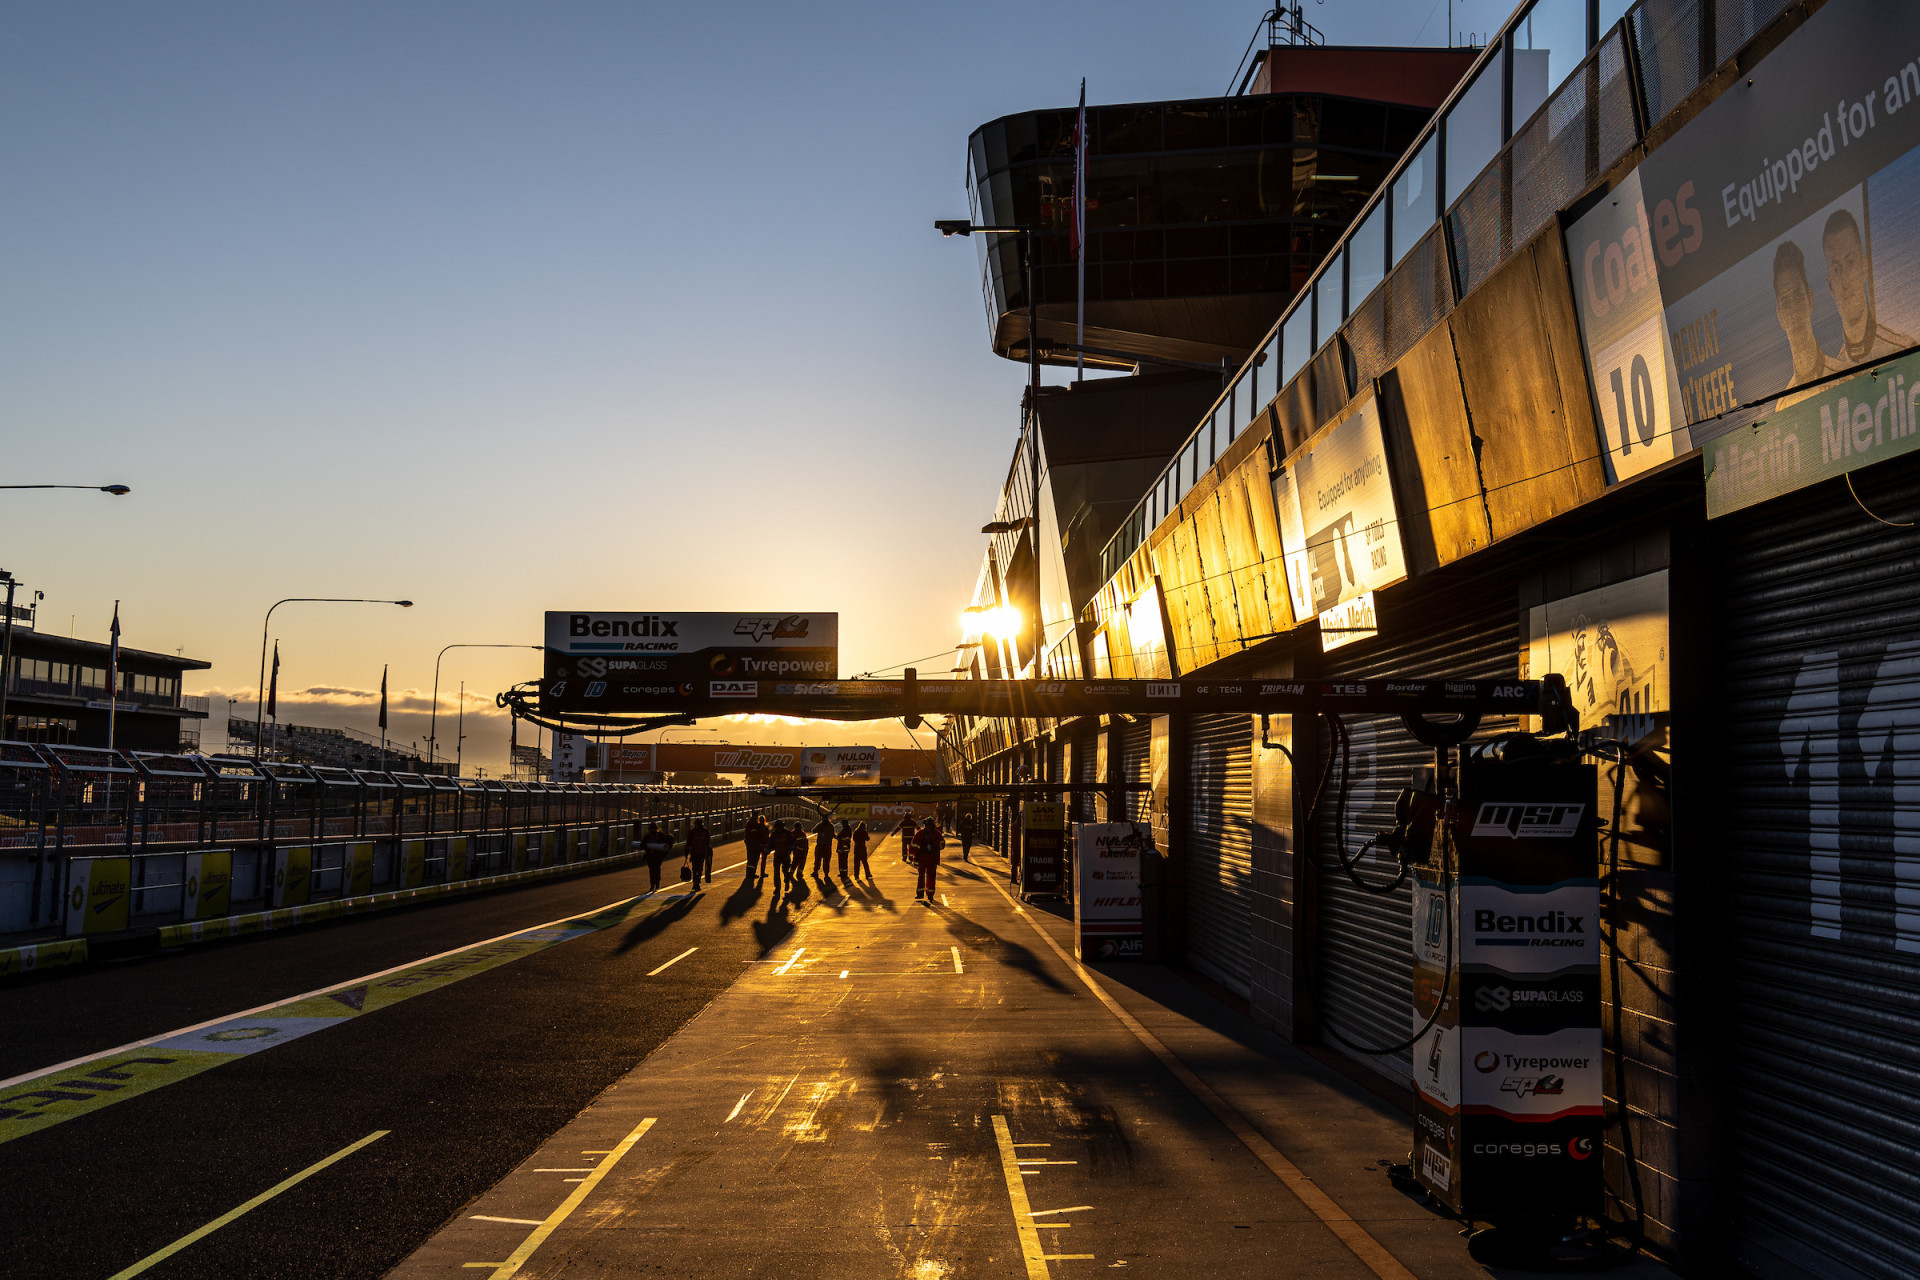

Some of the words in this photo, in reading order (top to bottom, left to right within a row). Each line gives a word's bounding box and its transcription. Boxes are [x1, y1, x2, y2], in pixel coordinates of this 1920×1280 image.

[1722, 113, 1835, 229] Equipped
[1837, 84, 1877, 147] for
[1884, 56, 1920, 115] an
[1672, 308, 1720, 374] PERCAT
[1682, 362, 1738, 426] O'KEEFE
[1610, 354, 1655, 457] 10
[1715, 426, 1800, 502] Merlin
[1317, 474, 1345, 511] Equipped
[1344, 471, 1354, 492] for
[1354, 454, 1382, 486] anything
[570, 614, 679, 637] Bendix
[624, 642, 679, 651] RACING
[608, 660, 667, 670] SUPAGLASS
[741, 657, 833, 675] Tyrepower
[549, 681, 567, 697] 4
[623, 685, 676, 695] coregas
[711, 683, 757, 692] DAF
[1034, 683, 1067, 693] AGI
[1332, 685, 1368, 694] TES
[1386, 683, 1427, 691] Border
[1444, 681, 1477, 692] higgins
[622, 749, 648, 758] Repco
[735, 750, 794, 770] Repco
[837, 752, 875, 761] NULON
[203, 871, 228, 885] ultimate
[92, 880, 126, 896] ultimate
[1425, 892, 1445, 949] 10
[1474, 909, 1585, 934] Bendix
[1530, 938, 1585, 947] RACING
[1512, 990, 1584, 1002] SUPAGLASS
[1504, 1054, 1590, 1071] Tyrepower
[1418, 1113, 1446, 1139] coregas
[1474, 1143, 1562, 1157] coregas
